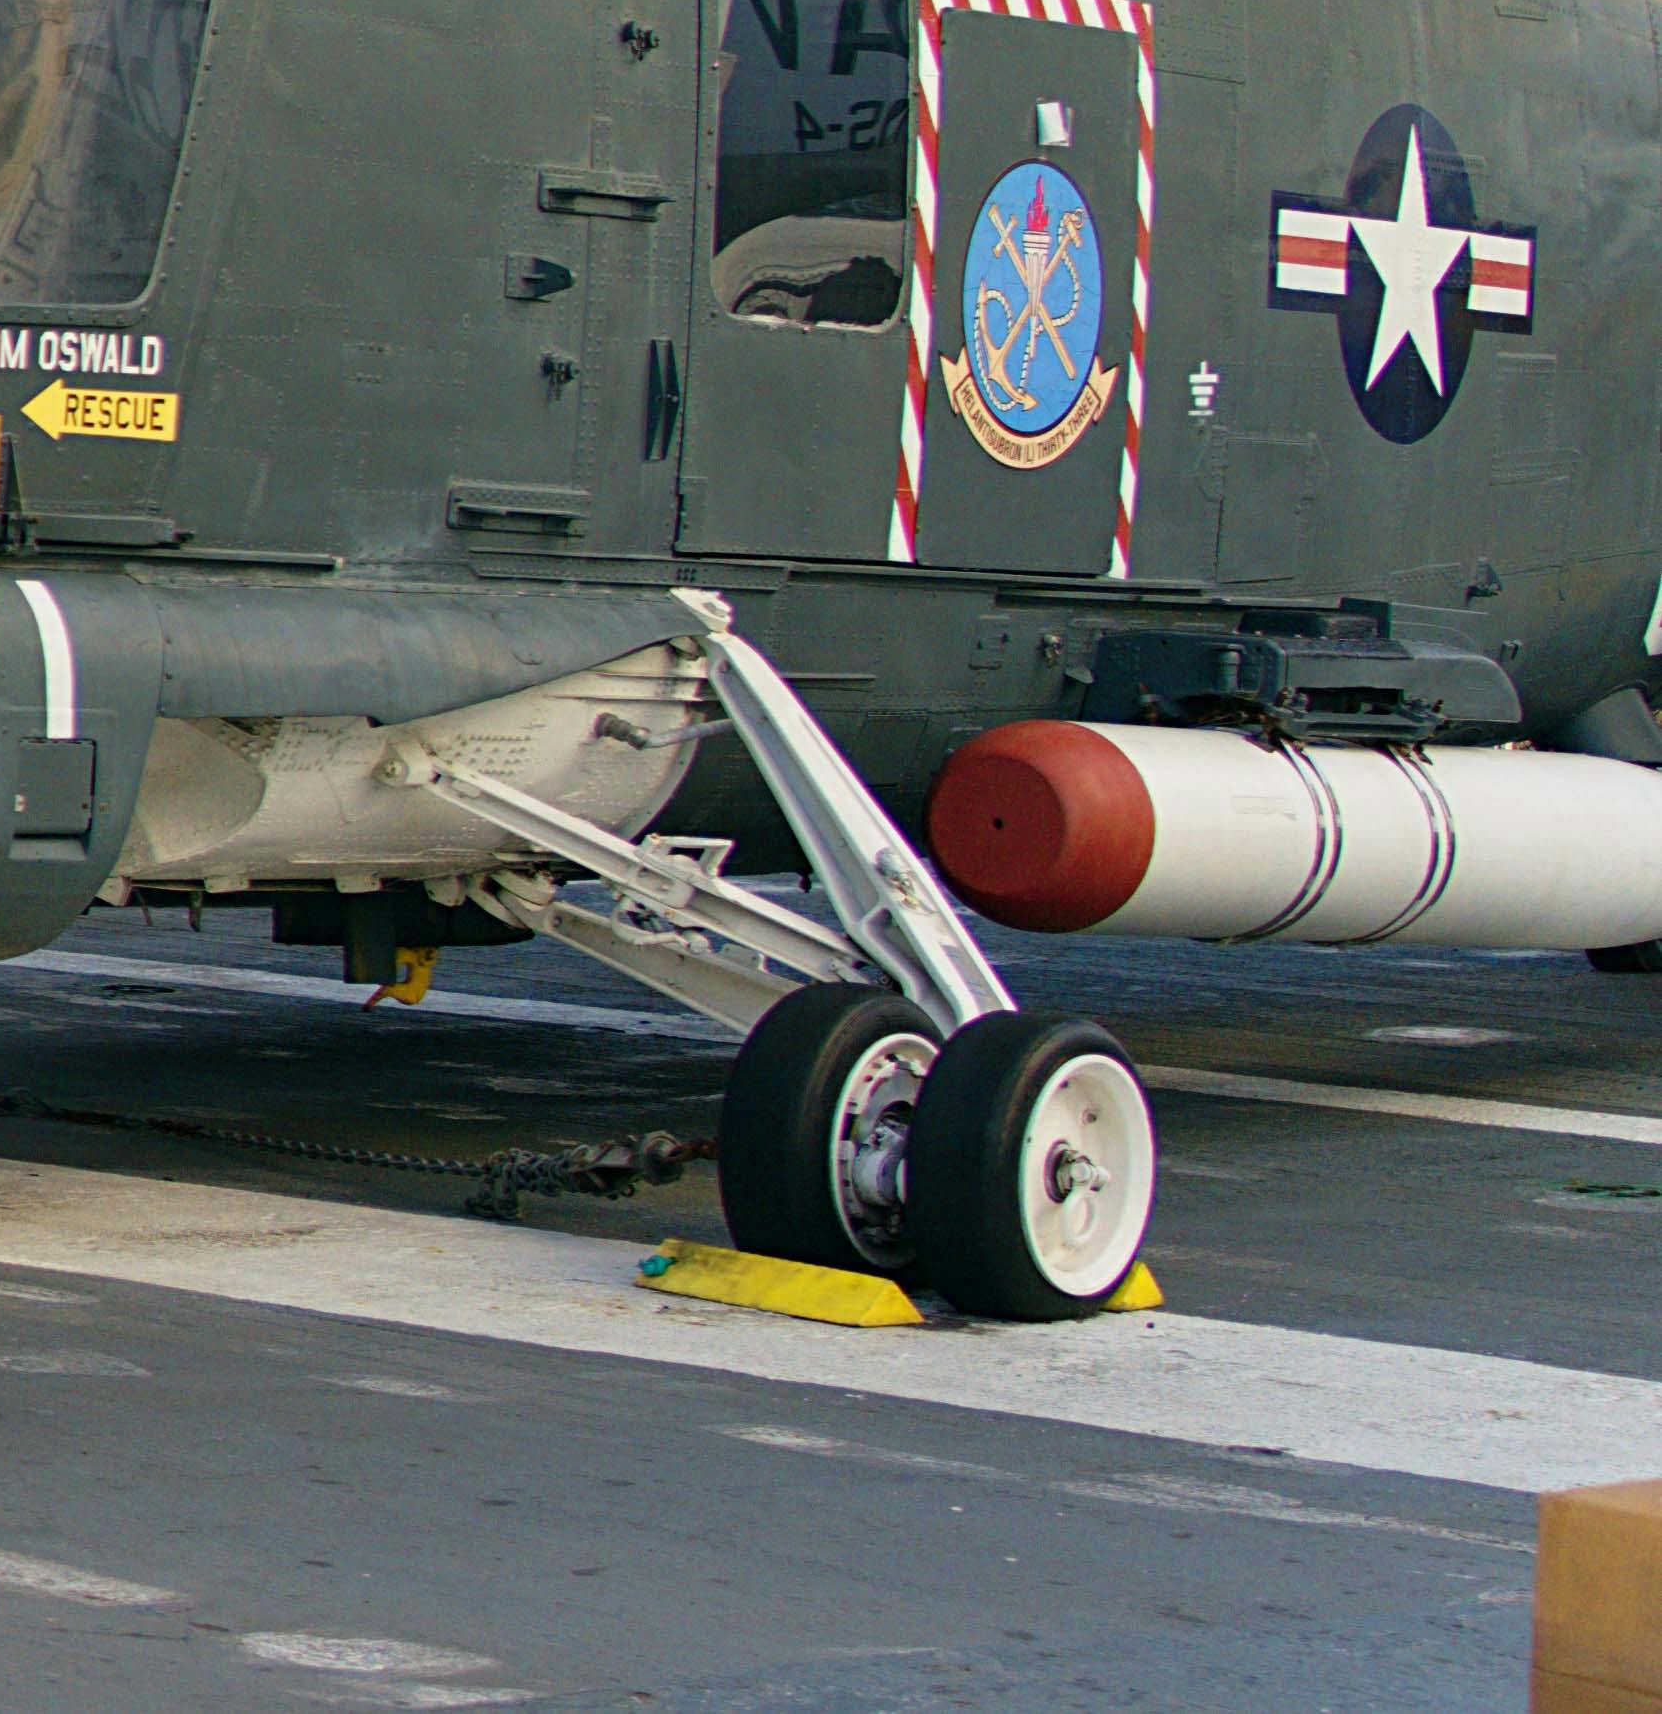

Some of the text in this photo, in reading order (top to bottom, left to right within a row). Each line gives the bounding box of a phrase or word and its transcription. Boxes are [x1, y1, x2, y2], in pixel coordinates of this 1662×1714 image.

[38, 331, 164, 375] OSWALD
[65, 394, 166, 431] RESCUE
[1037, 393, 1094, 460] THIRTY-THREE
